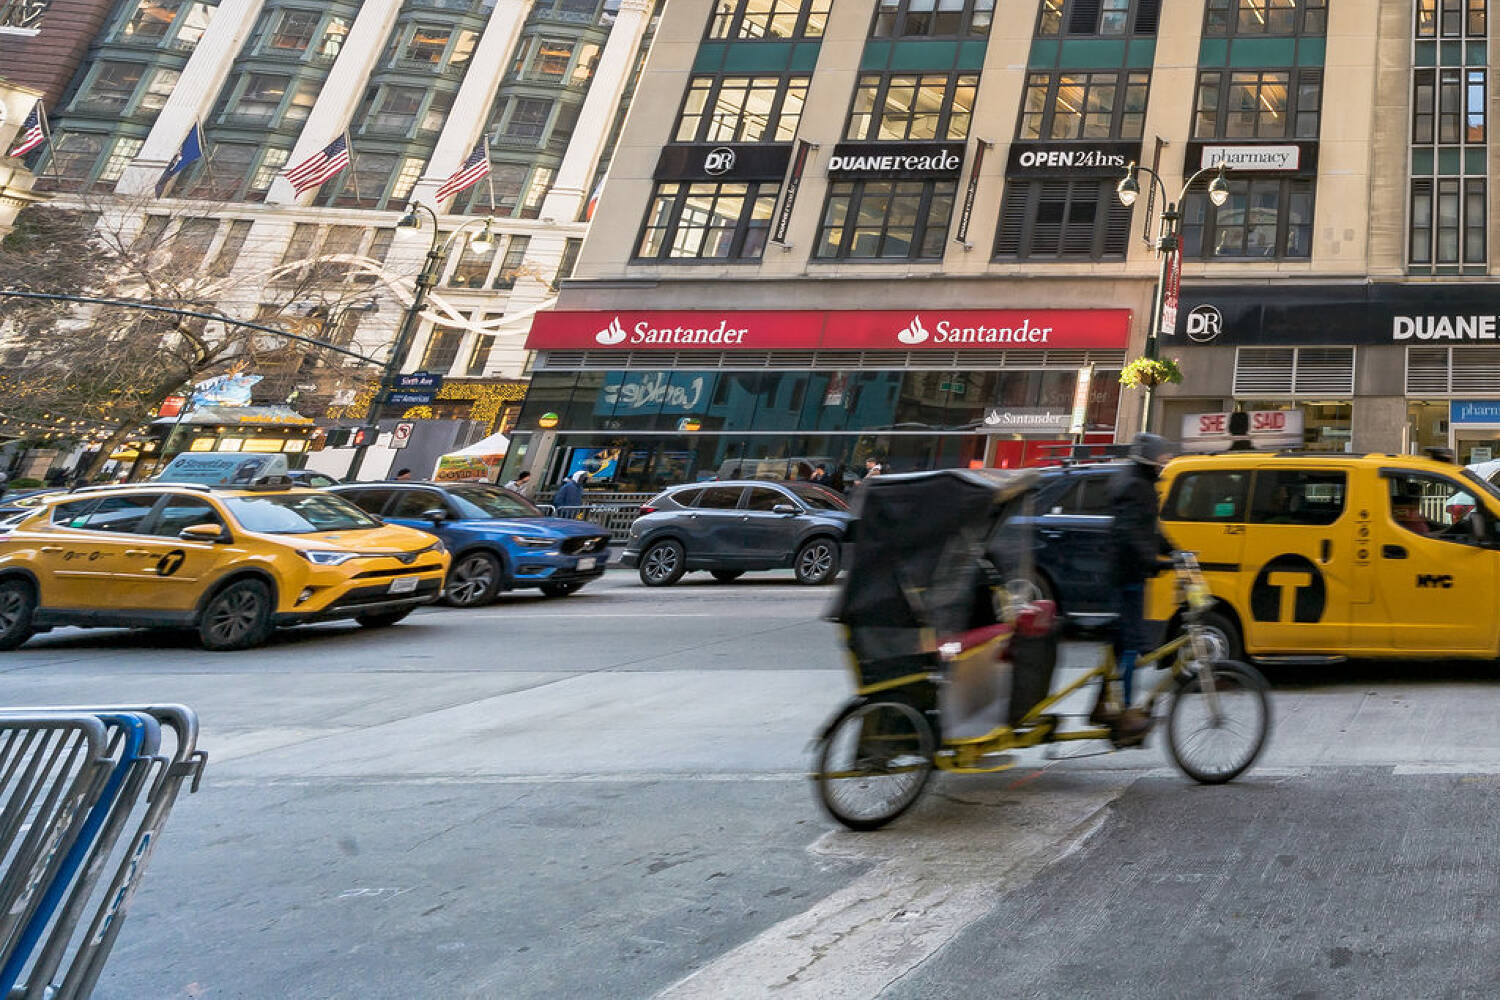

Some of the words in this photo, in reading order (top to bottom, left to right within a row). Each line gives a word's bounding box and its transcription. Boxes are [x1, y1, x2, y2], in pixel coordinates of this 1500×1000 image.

[704, 147, 736, 176] DR
[1210, 148, 1290, 168] pharmacy
[630, 320, 748, 344] Santander
[933, 320, 1052, 344] Santander
[1187, 304, 1222, 342] DR
[1003, 411, 1063, 426] Santander
[1200, 414, 1226, 432] SHE
[1253, 412, 1286, 430] SAID
[1415, 574, 1454, 588] NYC
